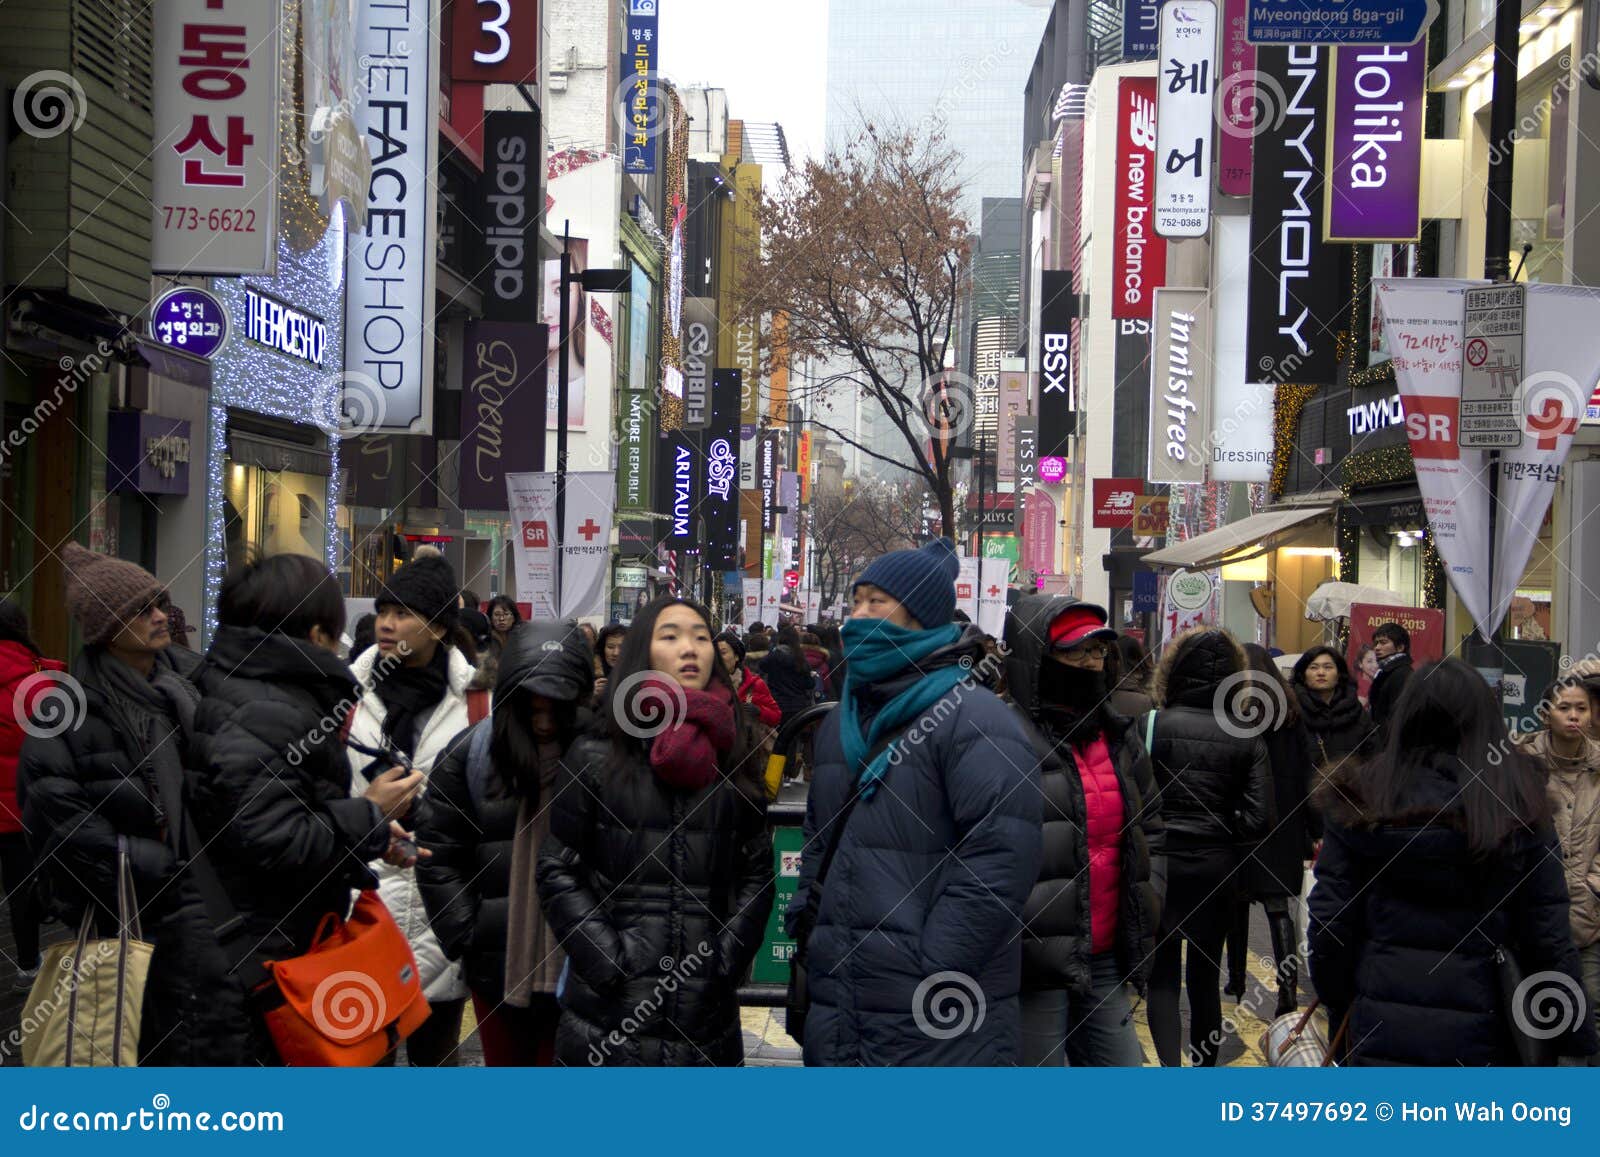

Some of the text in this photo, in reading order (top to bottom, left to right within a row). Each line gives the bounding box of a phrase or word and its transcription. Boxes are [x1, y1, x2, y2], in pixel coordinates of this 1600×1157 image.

[473, 0, 511, 64] 3
[632, 28, 653, 41] 명동
[1254, 8, 1404, 24] Myeongdong 8ga-gil
[172, 0, 254, 188] 동산
[633, 43, 650, 147] 드림성모안과
[162, 206, 257, 233] 773-6622
[486, 136, 527, 300] adidas
[1124, 153, 1148, 304] new balance
[1161, 218, 1202, 227] 752-0368
[246, 290, 327, 364] THEFACESHOP
[687, 361, 706, 424] FUBU
[1043, 334, 1068, 393] BSX
[1164, 310, 1196, 461] innisfree
[470, 340, 518, 483] Roem
[1406, 414, 1450, 442] SR
[627, 394, 641, 505] NATURE REPUBLIC
[1041, 465, 1063, 473] ETUDE
[1213, 446, 1275, 465] Dressing
[674, 445, 691, 537] ARITAUM
[526, 528, 545, 541] SR
[1138, 516, 1169, 531] DVD
[1402, 619, 1426, 631] 2013
